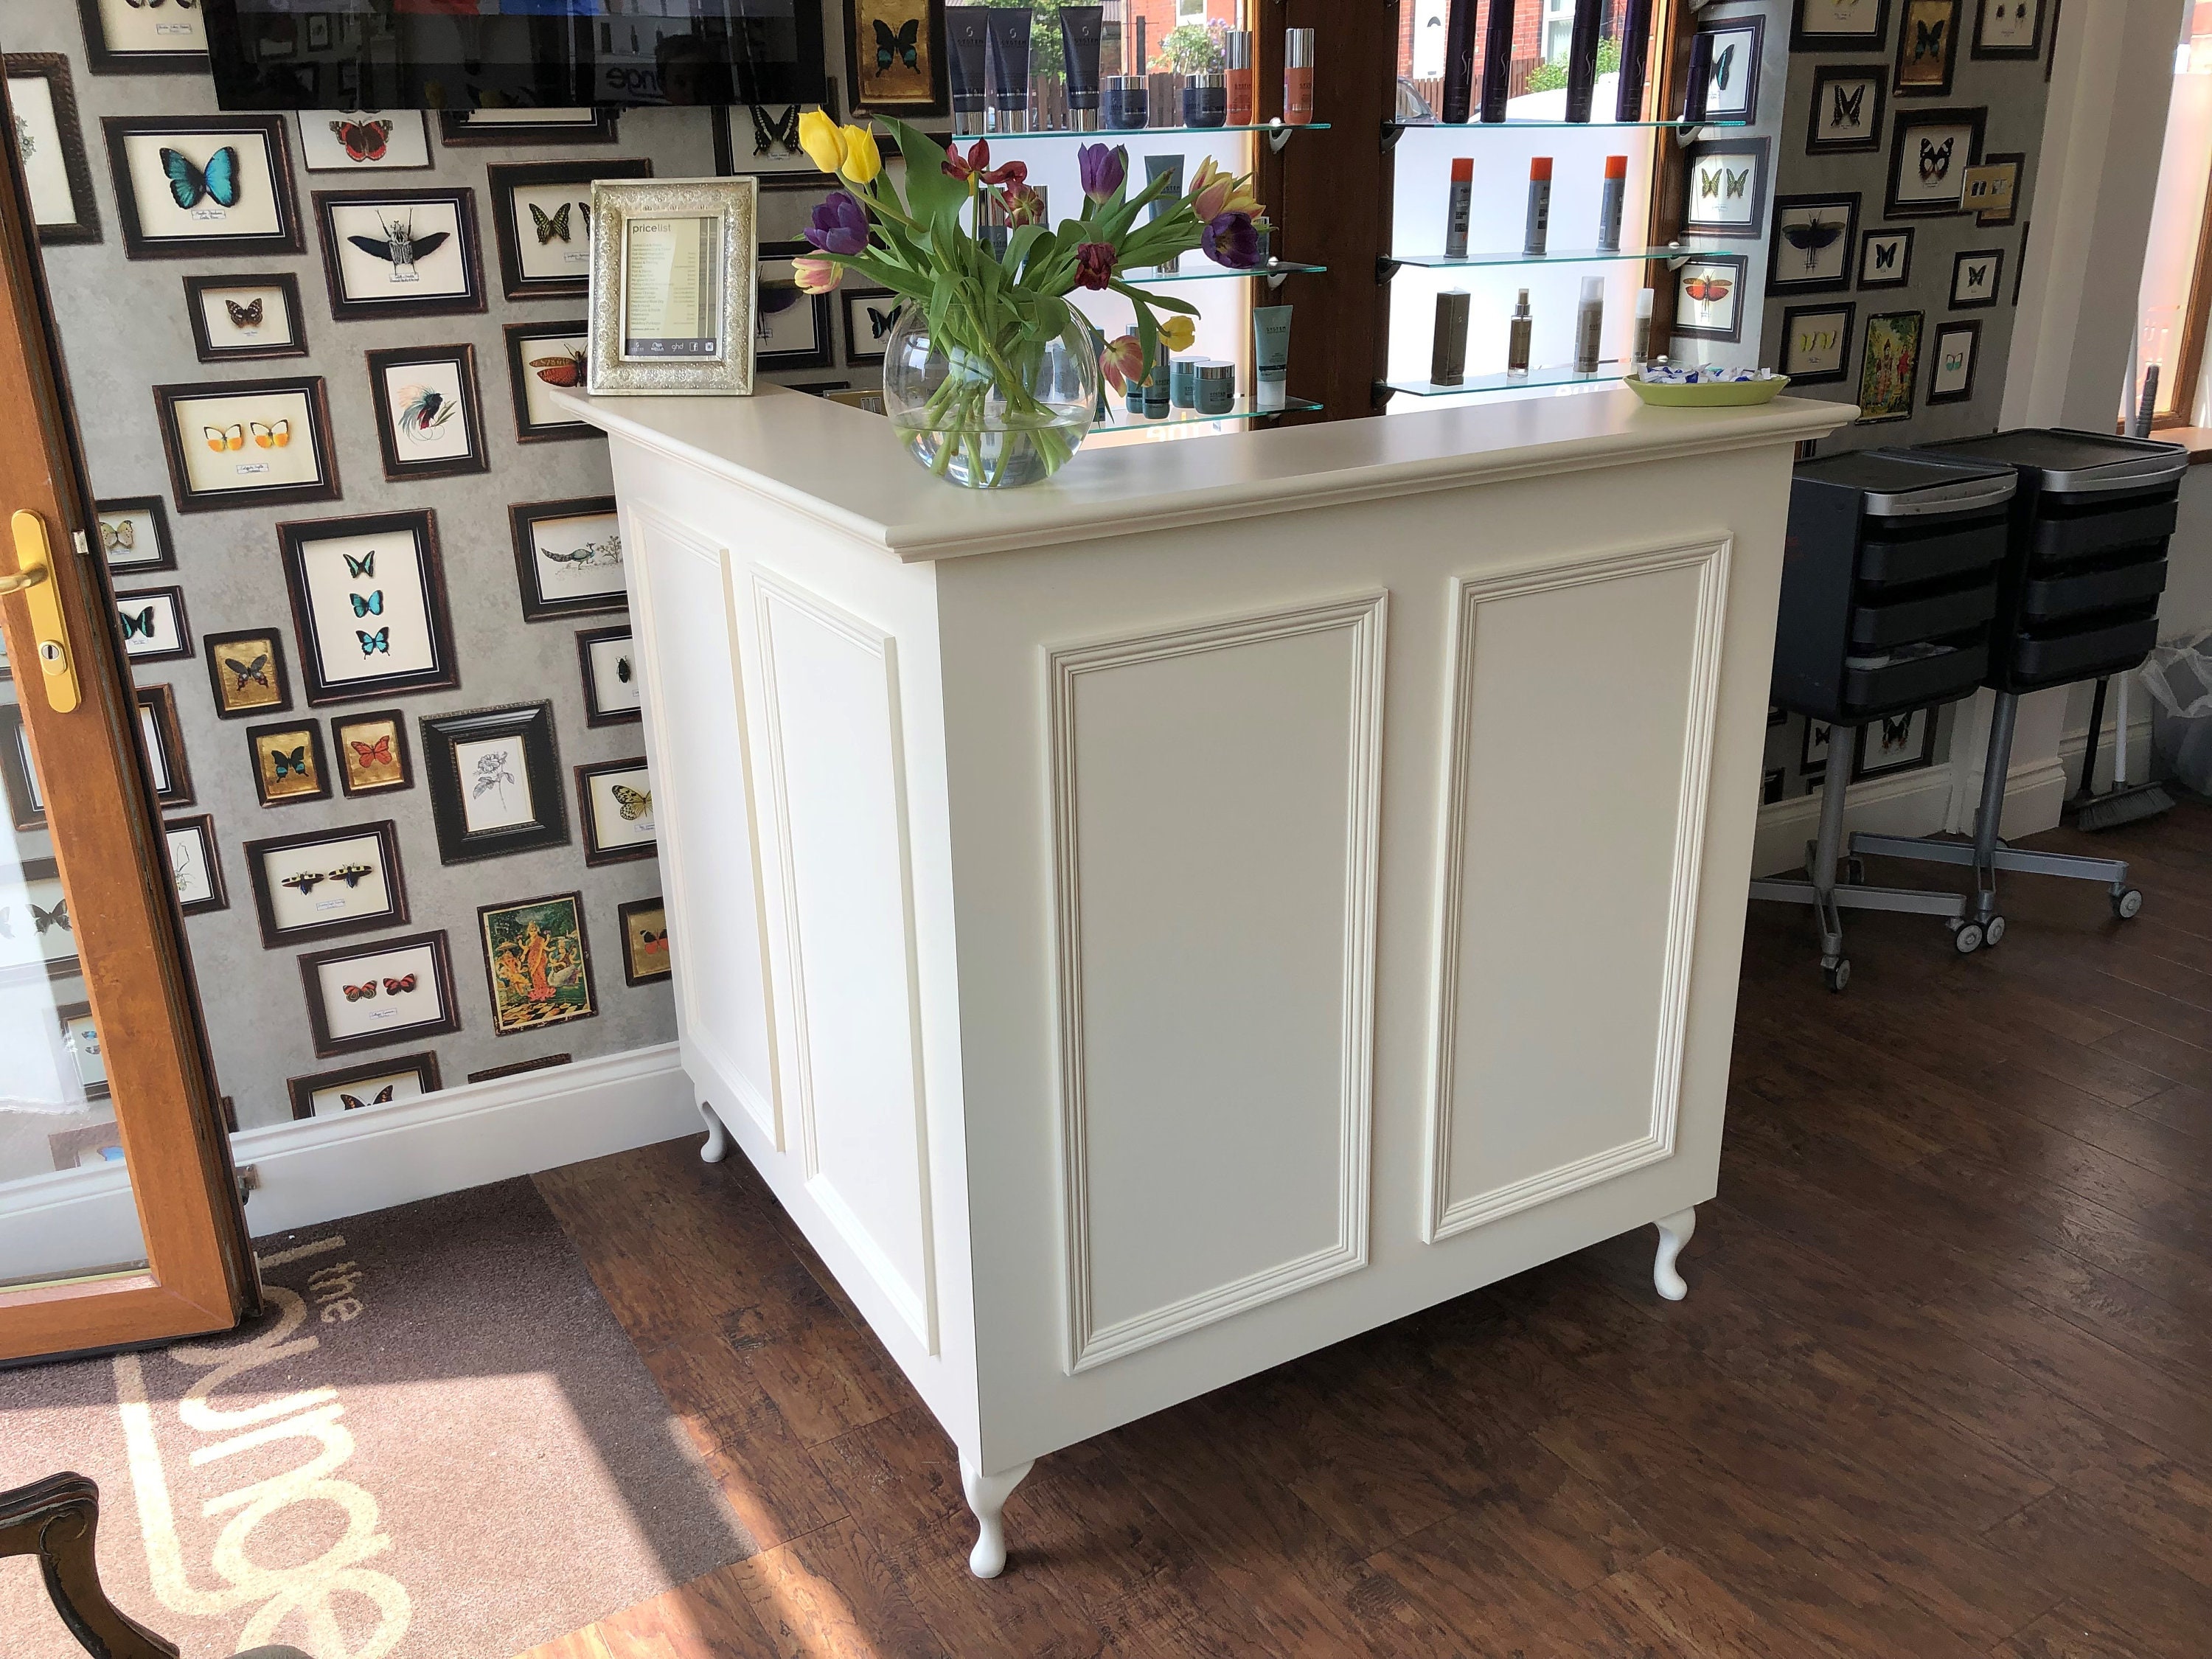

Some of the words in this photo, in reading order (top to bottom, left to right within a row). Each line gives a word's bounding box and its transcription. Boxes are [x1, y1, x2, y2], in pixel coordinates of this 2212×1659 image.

[633, 223, 671, 234] pricelist
[671, 342, 684, 352] ghd
[307, 1260, 368, 1324] the
